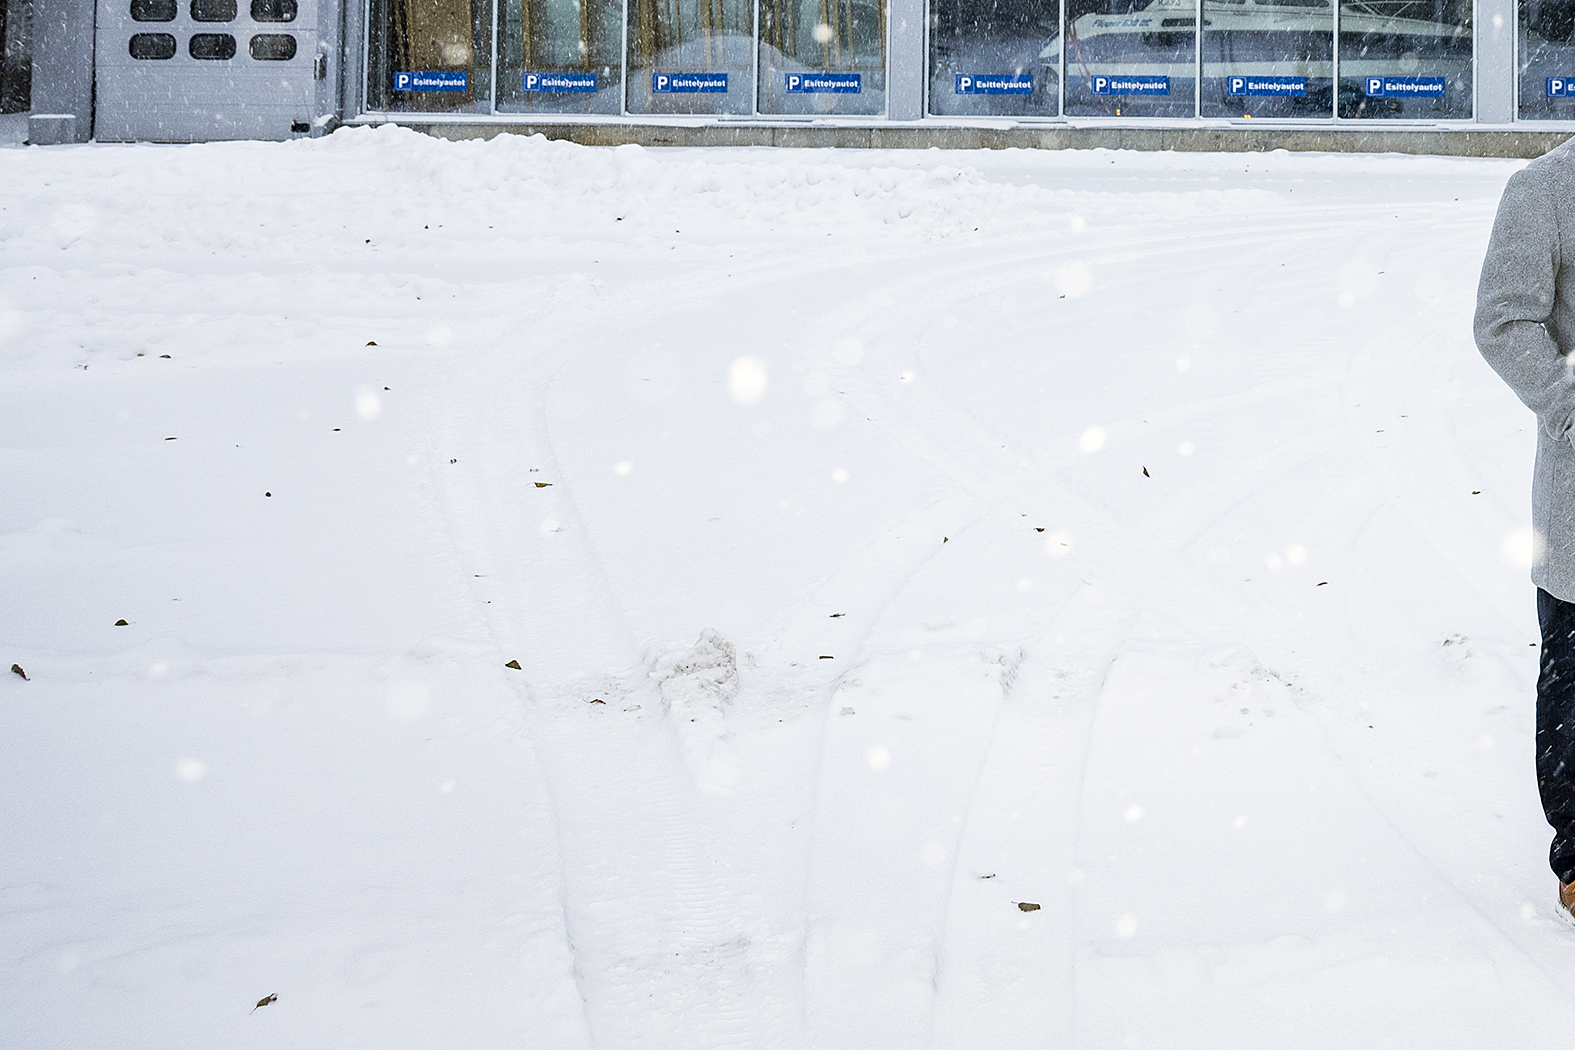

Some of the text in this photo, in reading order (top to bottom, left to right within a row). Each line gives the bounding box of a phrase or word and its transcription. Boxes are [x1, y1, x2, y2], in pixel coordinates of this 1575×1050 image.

[398, 74, 409, 89] P
[527, 75, 537, 89] P
[657, 75, 726, 90] P Esittelyautot
[789, 76, 857, 90] P Esittelyautot
[961, 77, 1030, 91] P Esittelyautot
[1095, 78, 1166, 92] P Esittelyautot
[1232, 78, 1303, 93] P Esittelyautot
[1369, 79, 1441, 94] P Esittelyautot
[1551, 79, 1562, 95] P
